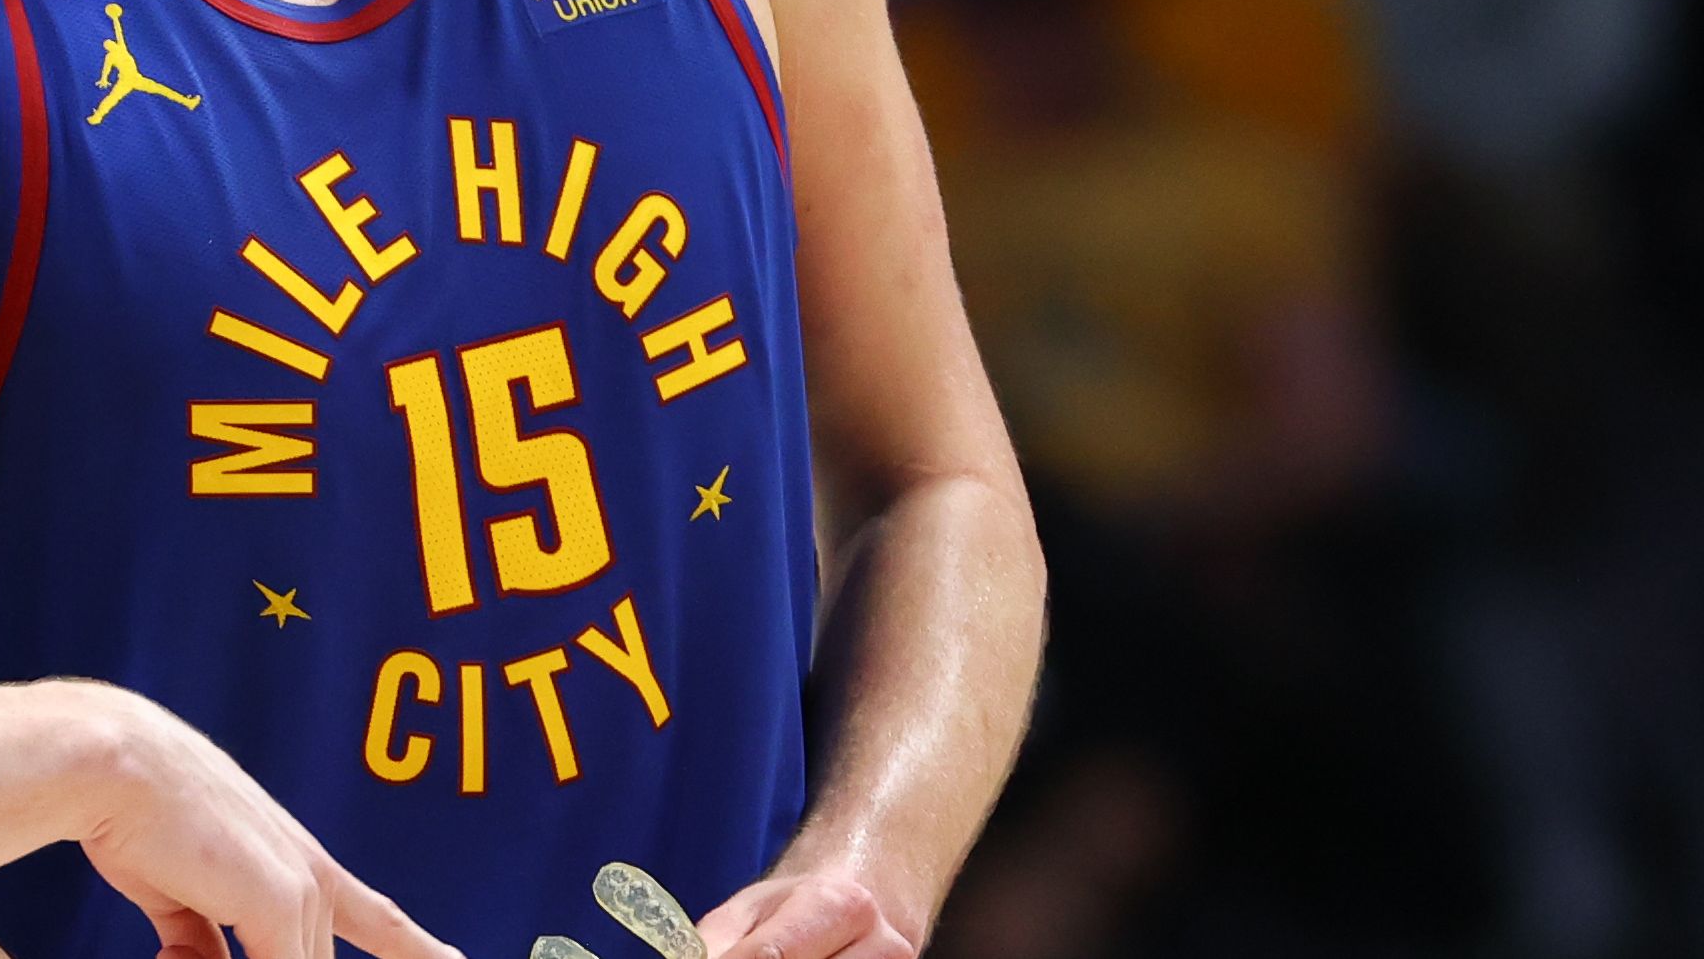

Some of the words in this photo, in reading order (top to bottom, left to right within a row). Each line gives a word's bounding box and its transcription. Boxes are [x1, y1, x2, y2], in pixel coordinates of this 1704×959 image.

[186, 149, 421, 498] MILE
[447, 115, 748, 404] HIGH
[386, 322, 612, 619] 15
[363, 592, 672, 796] CITY
